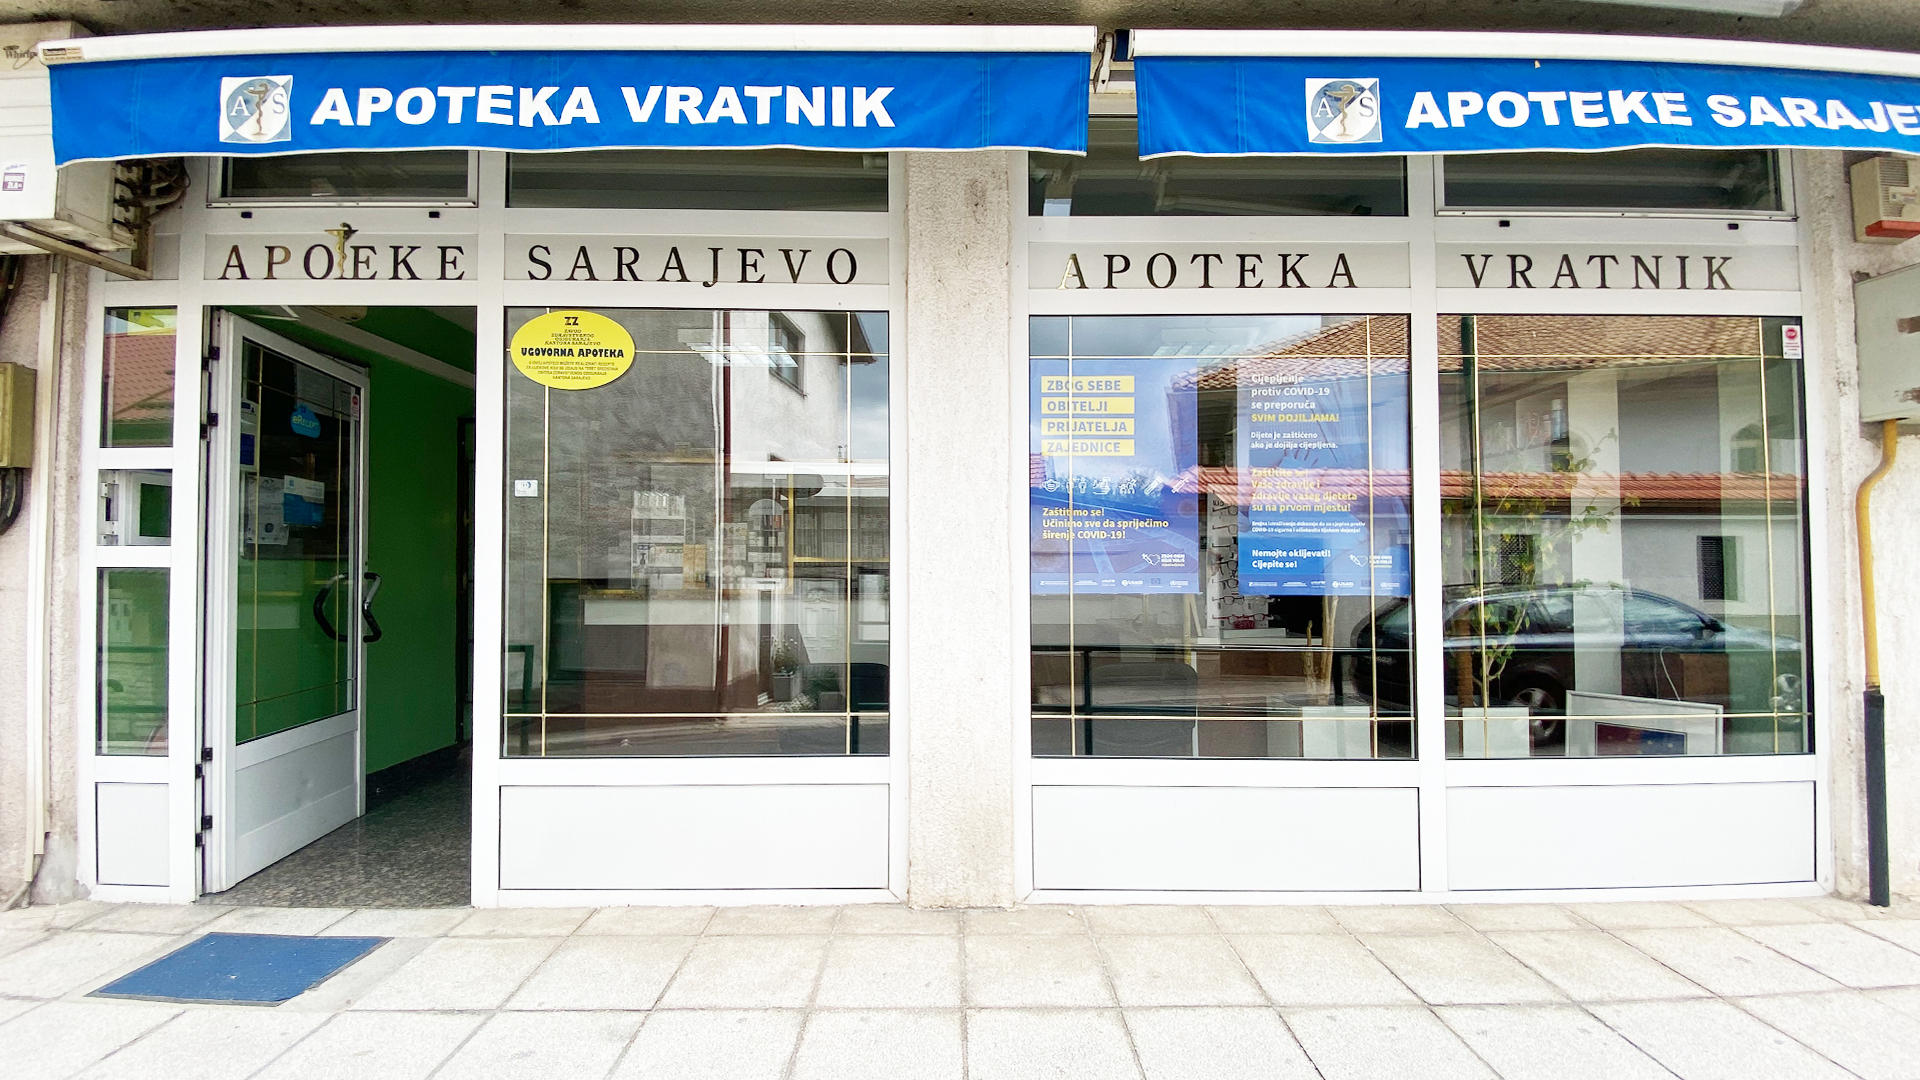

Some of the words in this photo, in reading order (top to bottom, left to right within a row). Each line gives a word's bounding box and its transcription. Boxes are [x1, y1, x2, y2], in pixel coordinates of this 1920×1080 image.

[310, 85, 600, 127] APOTEKA
[621, 85, 896, 127] VRATNIK
[1405, 90, 1693, 128] APOTEKE
[1706, 94, 1920, 135] SARAJE
[527, 245, 858, 288] SARAJEVO
[1056, 253, 1359, 289] APOTEKA
[1461, 253, 1736, 290] VRATNIK
[521, 347, 575, 357] UGOVORNA
[578, 348, 625, 358] APOTEKA
[1251, 374, 1304, 385] Cijepljenje
[1047, 380, 1084, 391] ZBOG
[1087, 380, 1121, 391] SEBE
[1251, 386, 1281, 397] protiv
[1283, 387, 1330, 396] COVID-19
[1047, 401, 1108, 412] OBITELJI
[1264, 400, 1316, 411] preporuča
[1251, 413, 1276, 422] SVIM
[1278, 413, 1339, 422] DOJILJAMA!
[1047, 421, 1128, 432] PRIJATELJA
[1251, 431, 1273, 440] Dijete
[1273, 431, 1281, 440] je
[1282, 431, 1318, 439] zaštićeno
[1251, 441, 1264, 449] ako
[1265, 441, 1273, 450] je
[1251, 479, 1274, 488] Vaše
[1276, 480, 1315, 490] zdravlje
[1251, 491, 1291, 501] zdravlje
[1293, 491, 1321, 502] vašeg
[1323, 491, 1358, 502] djeteta
[1042, 507, 1089, 517] Zaštitmo
[1090, 508, 1105, 517] se!
[1279, 504, 1312, 513] prvom
[1313, 503, 1351, 513] mjestu!
[1042, 518, 1083, 528] Učinimo
[1084, 520, 1100, 528] sve
[1102, 519, 1116, 528] da
[1117, 519, 1169, 530] spriječimo
[1042, 530, 1075, 541] širenje
[1077, 530, 1126, 539] COVID-19!
[1252, 549, 1287, 559] Nemojte
[1288, 549, 1331, 559] oklijevati!
[1252, 560, 1284, 569] Cijepite
[1285, 560, 1298, 568] se!
